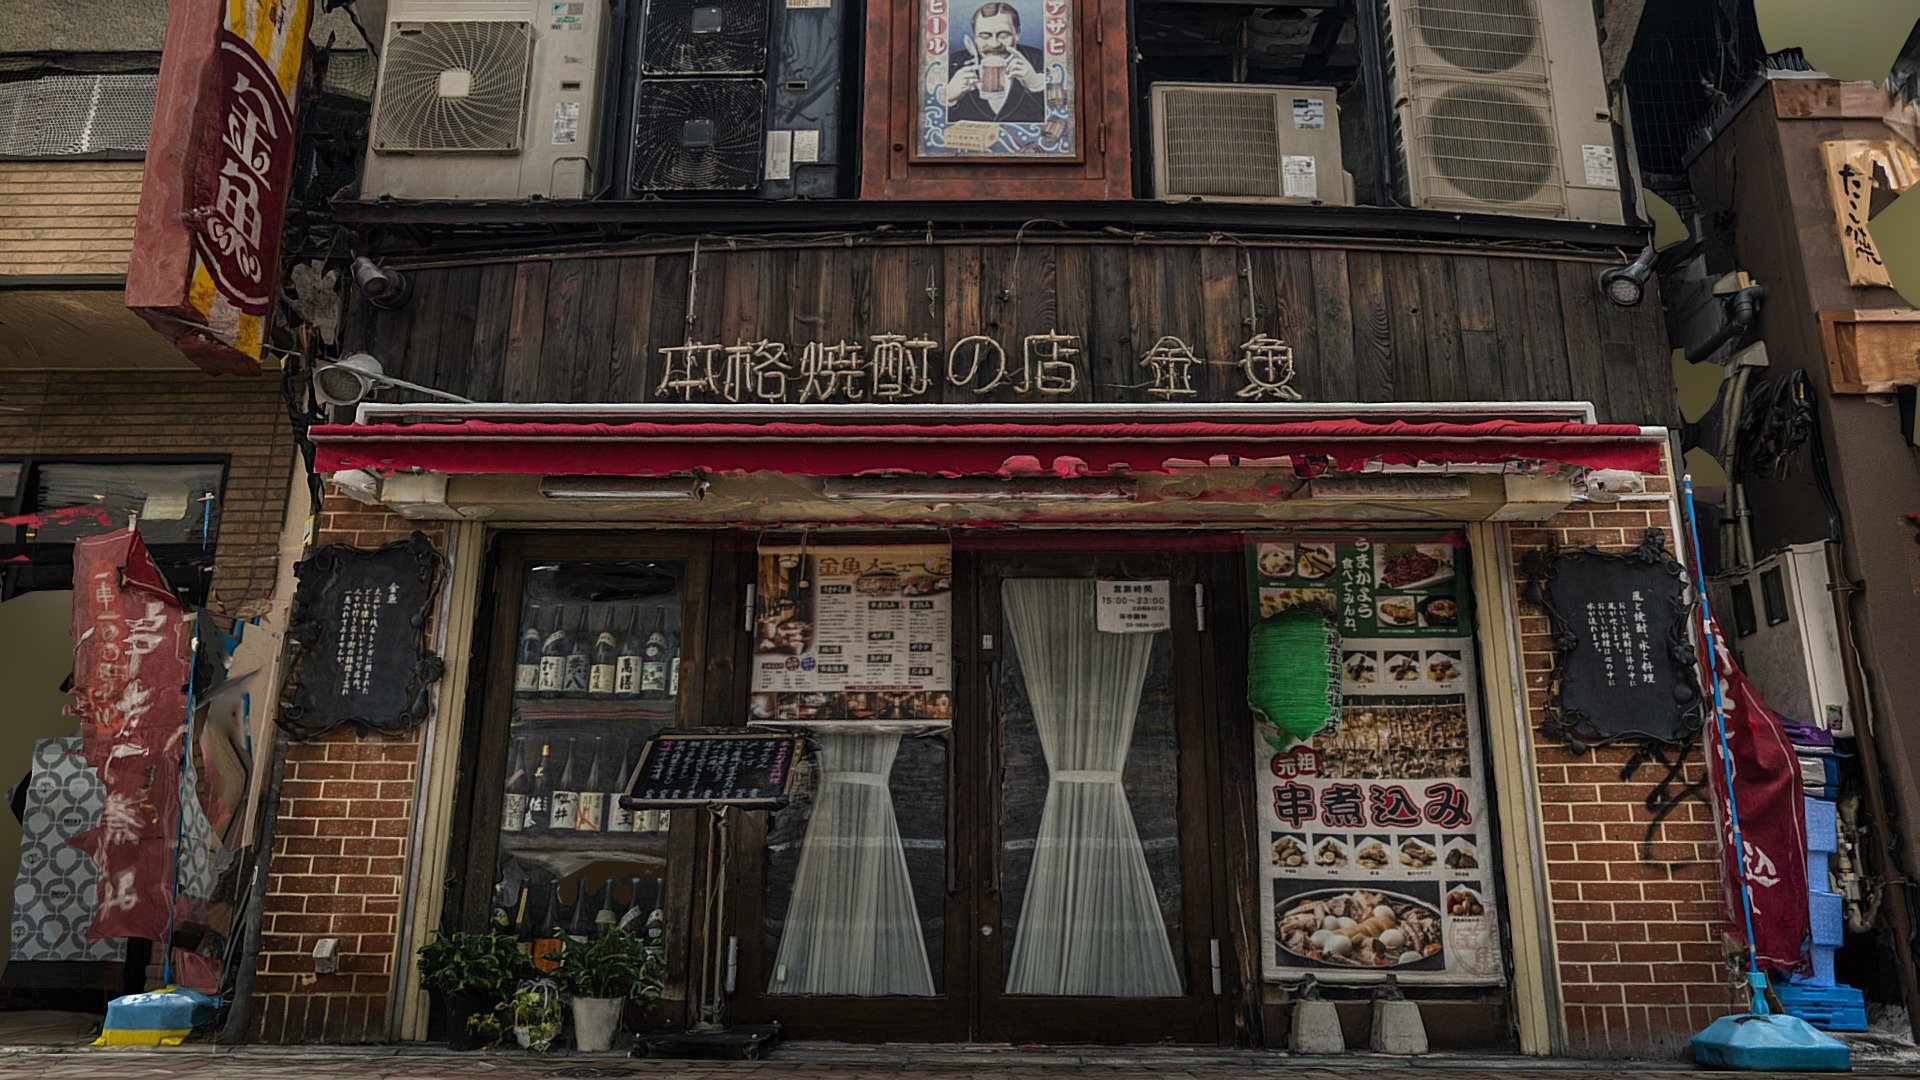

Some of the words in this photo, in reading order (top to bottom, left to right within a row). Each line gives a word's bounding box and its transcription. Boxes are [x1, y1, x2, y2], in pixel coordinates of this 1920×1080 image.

[655, 329, 1081, 402] 本格焼酎の店
[387, 582, 400, 604] 金魚
[1341, 557, 1358, 633] 食べてみんね。
[1586, 602, 1602, 653] 水が流れます。
[1608, 601, 1623, 653] 風が吹きます。
[1632, 590, 1655, 684] 風と焼酎、水と料理
[1277, 753, 1317, 776] 元祖
[1273, 781, 1472, 829] 串煮込み
